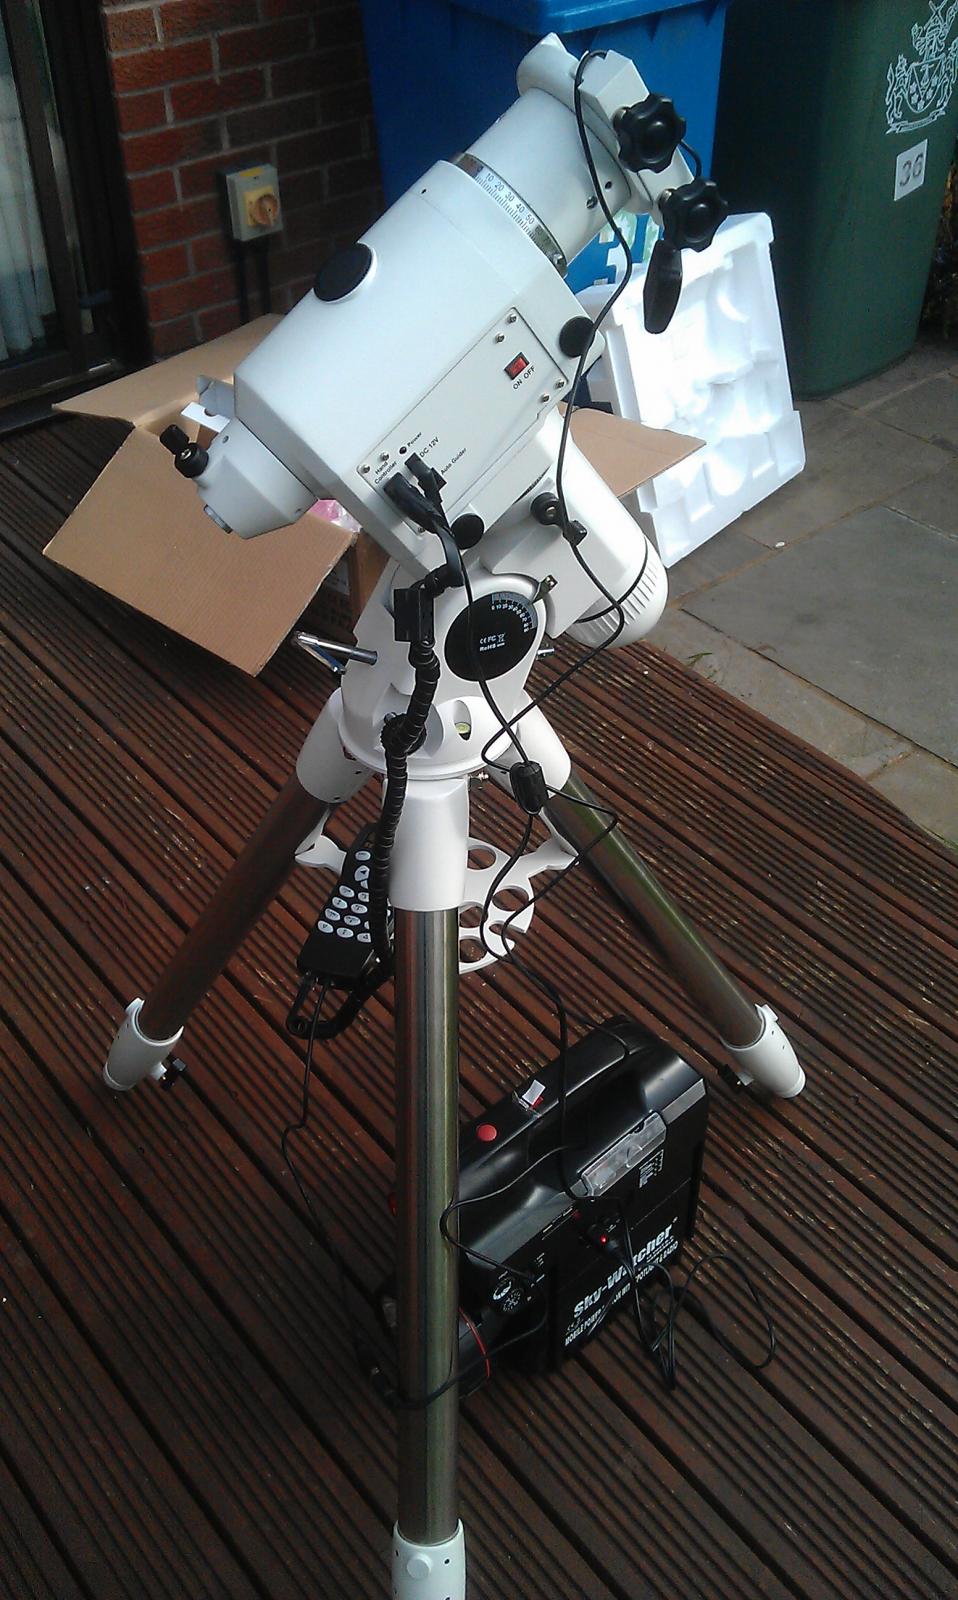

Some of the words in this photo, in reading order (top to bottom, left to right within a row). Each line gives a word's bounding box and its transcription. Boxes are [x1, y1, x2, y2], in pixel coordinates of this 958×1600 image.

[486, 173, 495, 182] 10
[494, 181, 505, 192] 20
[505, 191, 515, 202] 30
[516, 203, 526, 214] 40
[526, 214, 535, 225] 50
[513, 378, 522, 389] ON
[524, 366, 535, 379] OFF
[407, 432, 422, 447] Power
[419, 447, 429, 458] DC
[428, 436, 439, 448] 12V
[374, 461, 389, 475] Hand
[374, 460, 397, 485] Controller
[440, 463, 452, 475] Auto
[451, 447, 467, 464] Guider
